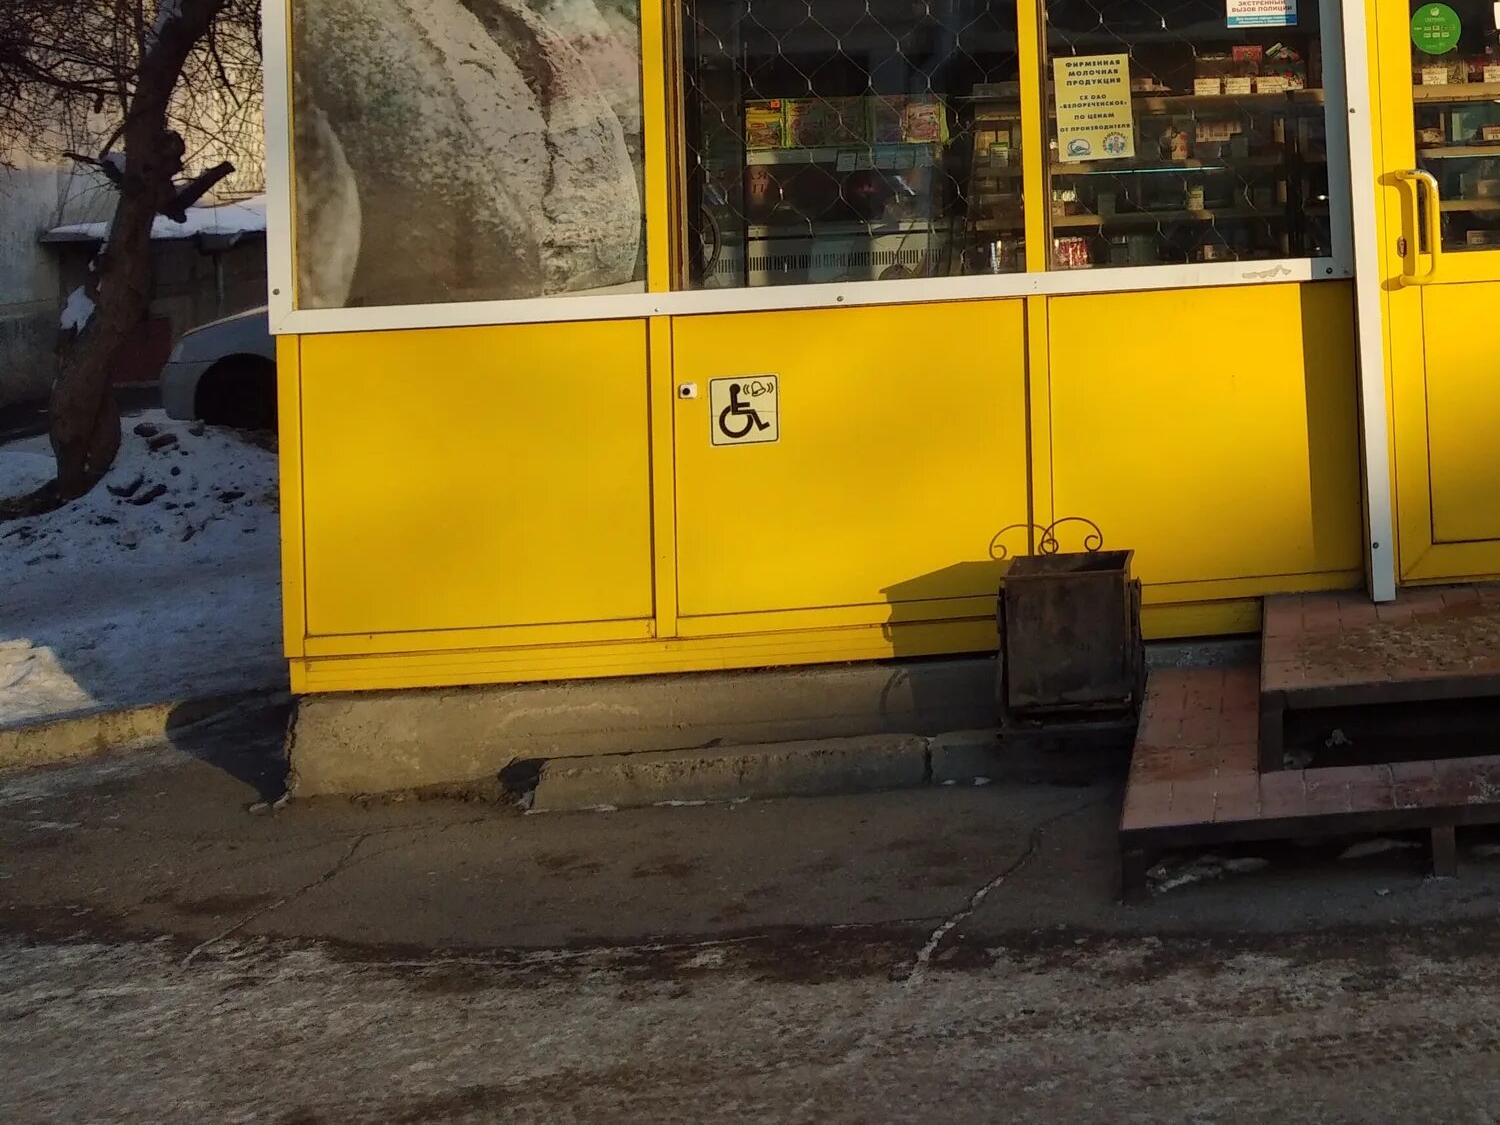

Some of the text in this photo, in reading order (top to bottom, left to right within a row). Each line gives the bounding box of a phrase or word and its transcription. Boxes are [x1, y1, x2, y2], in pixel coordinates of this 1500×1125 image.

[1065, 59, 1121, 68] ФИРМЕННАЯ
[1068, 68, 1119, 77] МОЛОЧНАЯ
[1066, 77, 1121, 86] ПРОДУКЦИЯ
[1070, 123, 1131, 132] ПРОИЗВОДИТЕЛЯ
